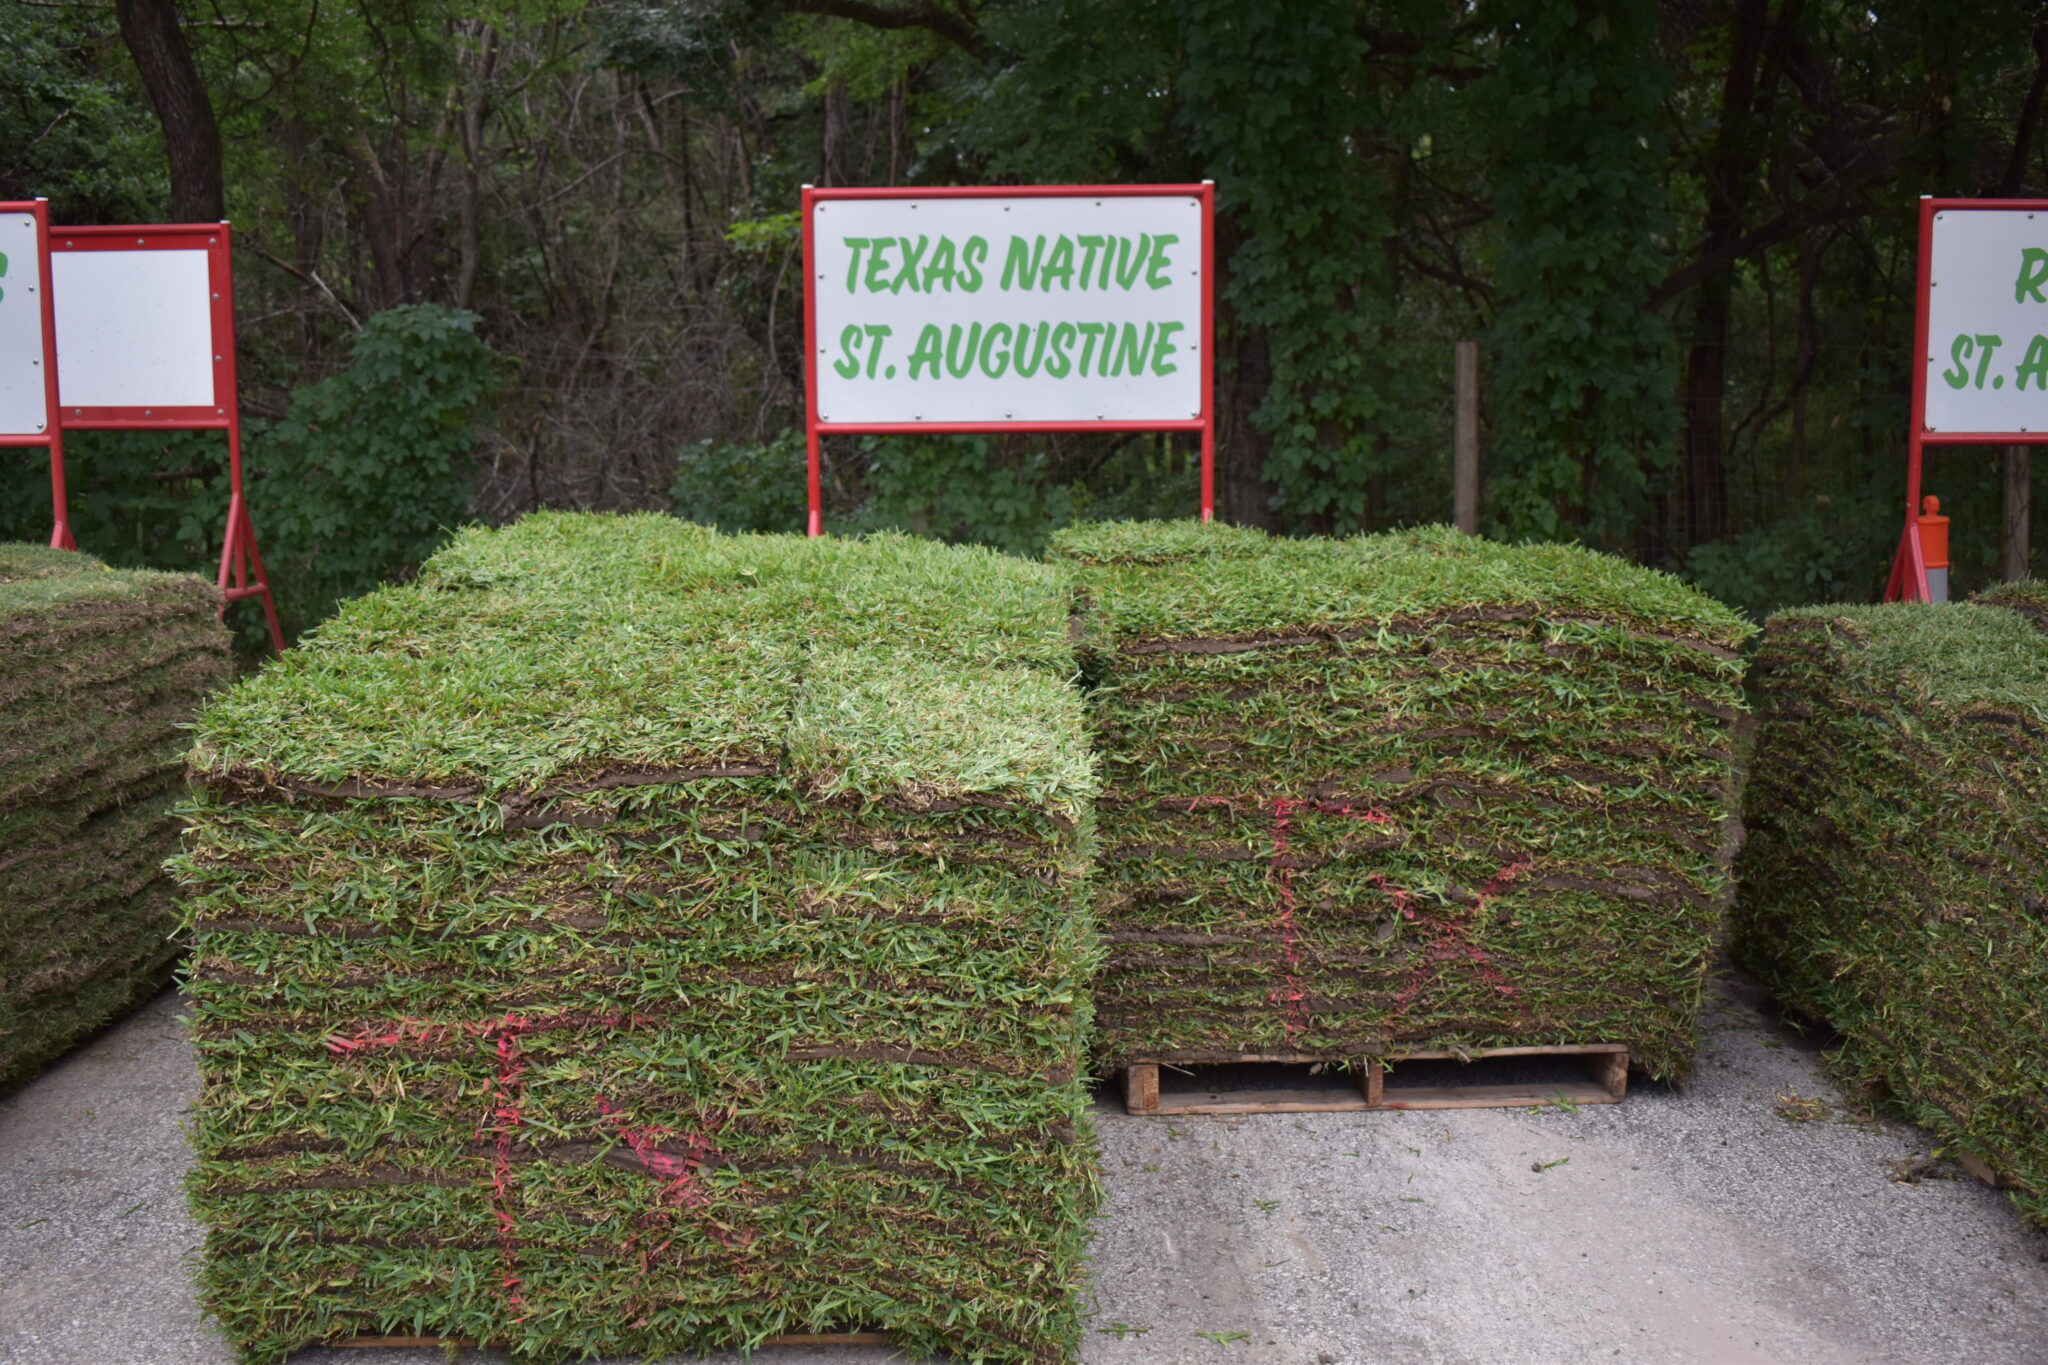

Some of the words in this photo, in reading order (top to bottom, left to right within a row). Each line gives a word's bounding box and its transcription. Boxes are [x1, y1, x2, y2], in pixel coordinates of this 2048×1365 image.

[843, 234, 989, 295] TEXAS
[1000, 233, 1180, 292] NATIVE
[833, 324, 897, 380] ST.
[908, 321, 1186, 380] AUGUSTINE
[1942, 333, 2004, 390] ST.
